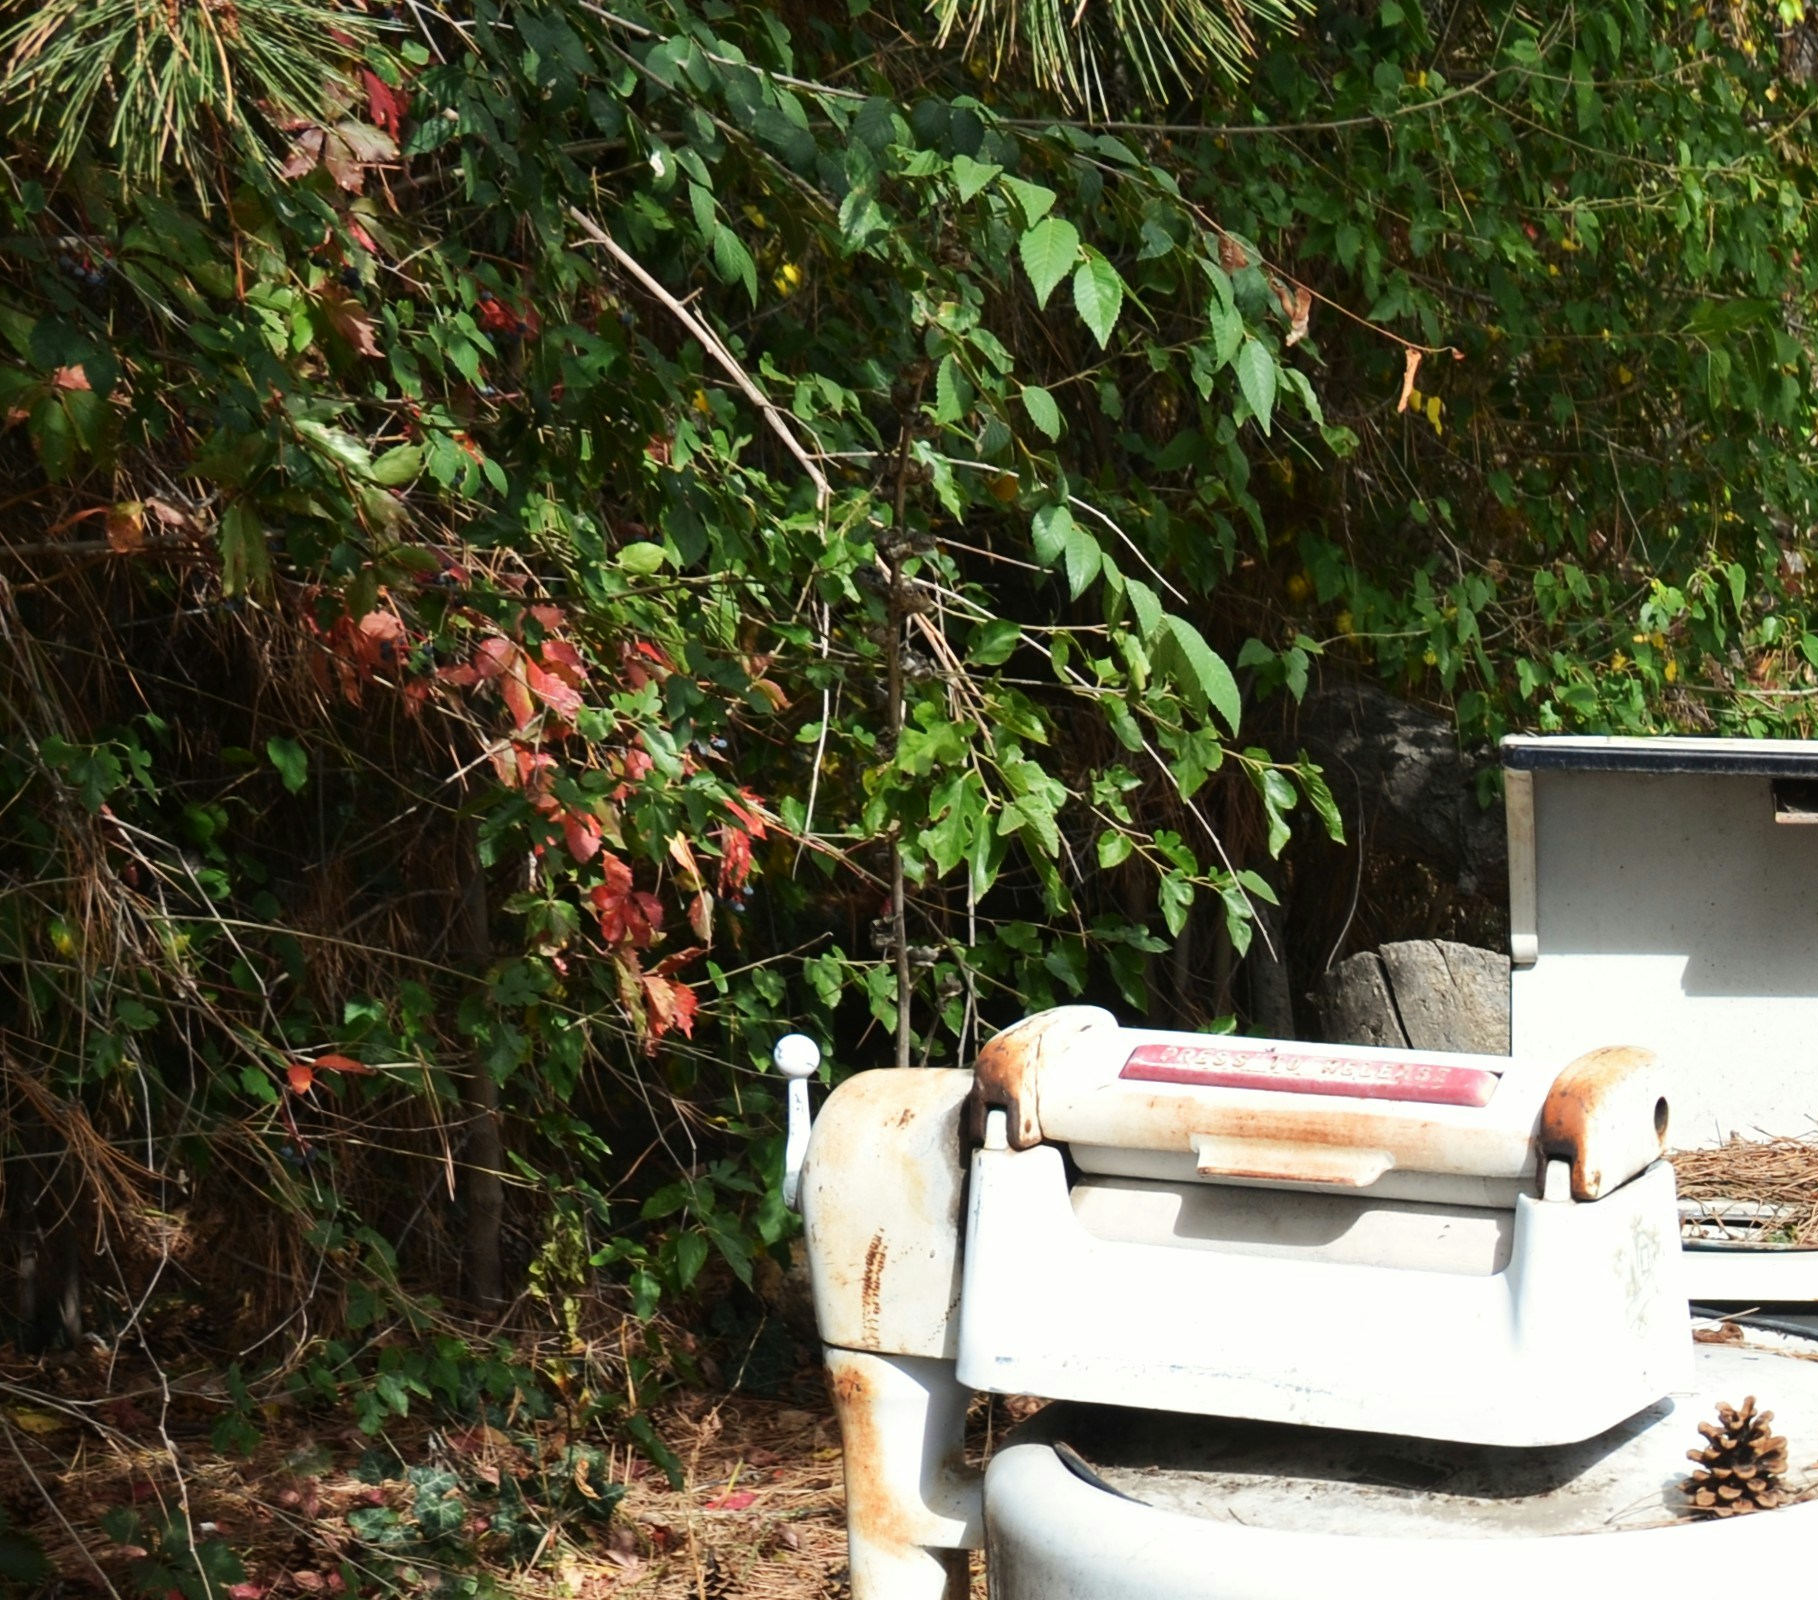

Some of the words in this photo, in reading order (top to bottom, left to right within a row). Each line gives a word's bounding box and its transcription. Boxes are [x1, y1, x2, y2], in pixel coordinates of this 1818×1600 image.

[1160, 1047, 1249, 1068] PRESS
[1269, 1055, 1300, 1071] TO
[1321, 1058, 1451, 1083] RELEASE
